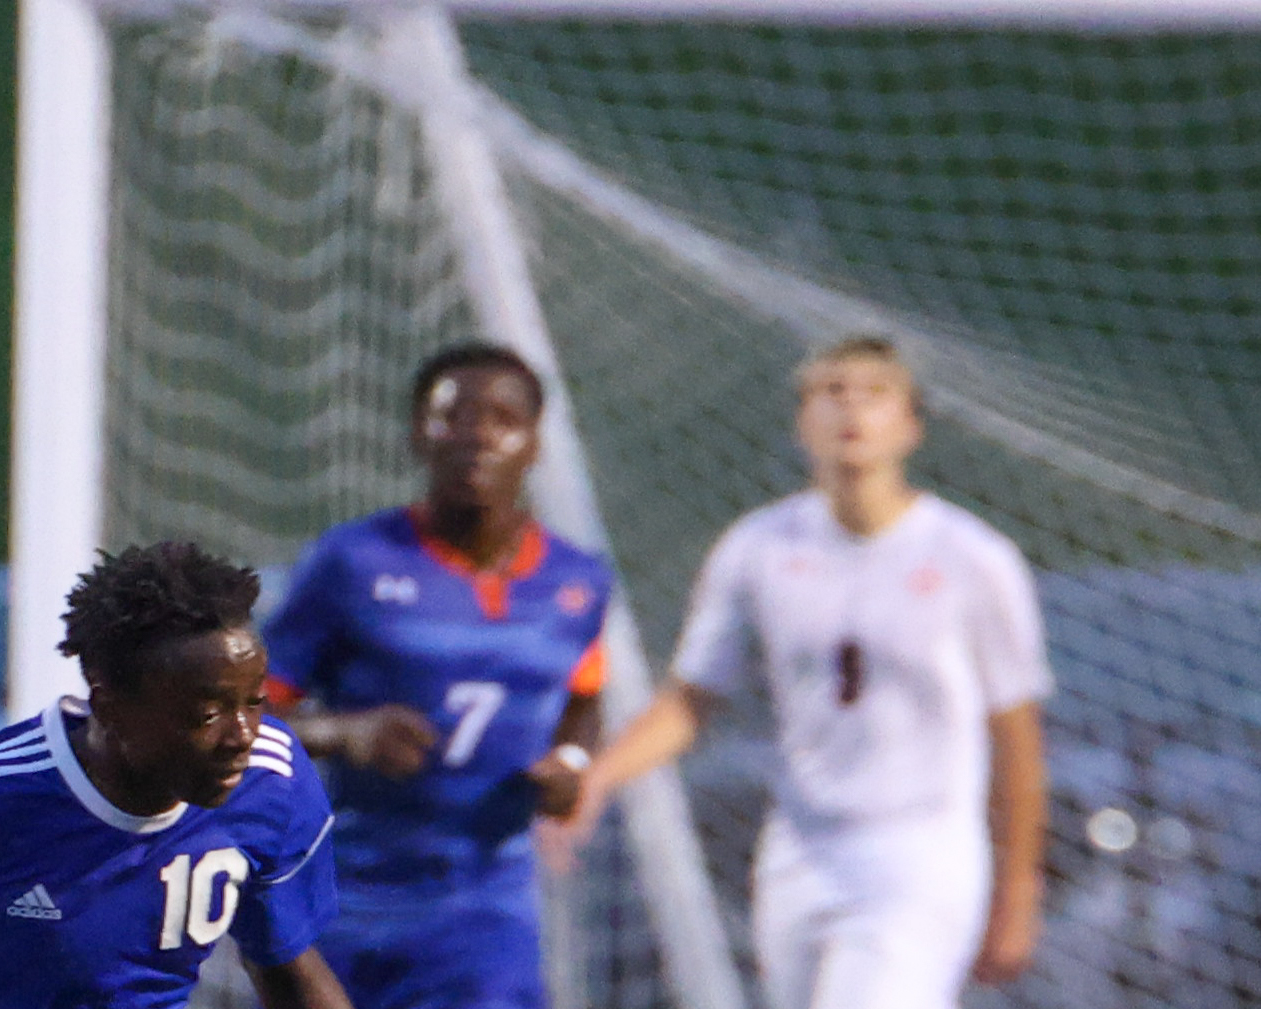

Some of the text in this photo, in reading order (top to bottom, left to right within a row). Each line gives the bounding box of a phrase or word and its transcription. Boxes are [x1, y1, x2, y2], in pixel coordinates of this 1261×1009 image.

[442, 681, 507, 767] 7
[7, 906, 62, 920] adidas
[160, 847, 249, 950] 10
